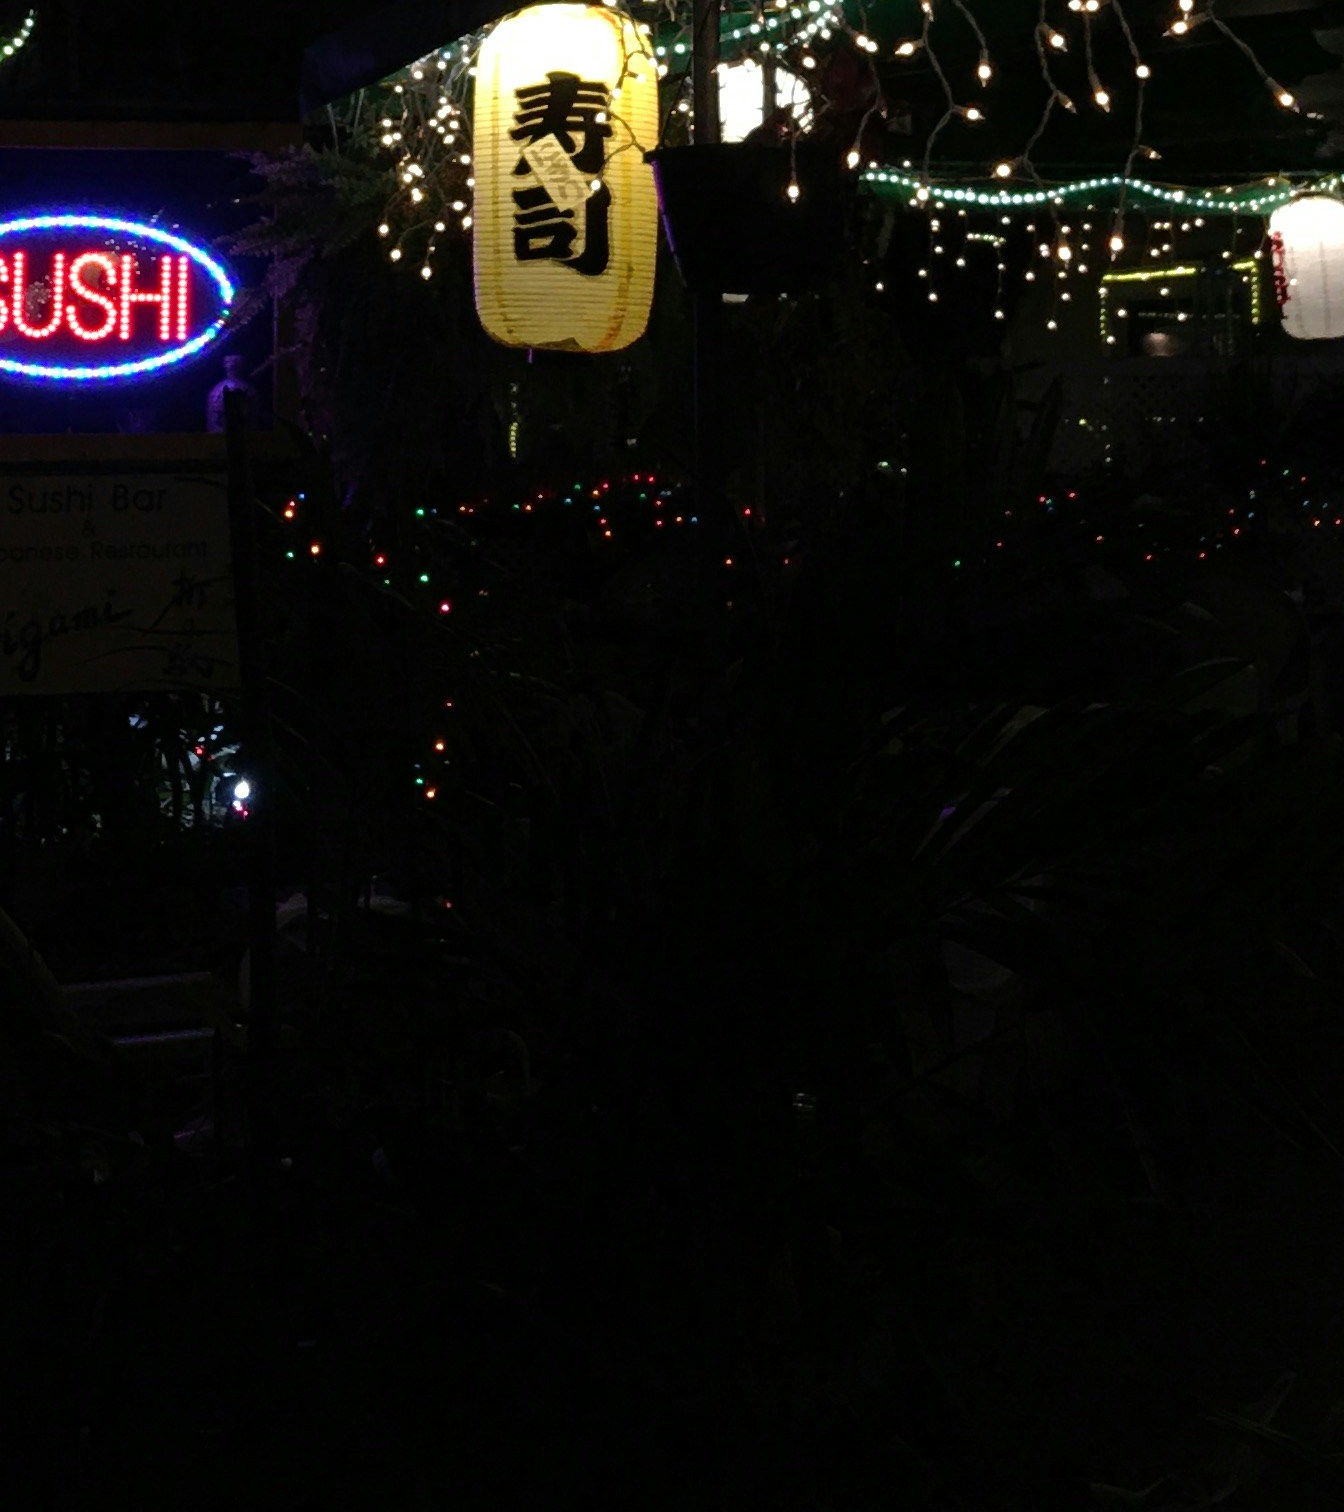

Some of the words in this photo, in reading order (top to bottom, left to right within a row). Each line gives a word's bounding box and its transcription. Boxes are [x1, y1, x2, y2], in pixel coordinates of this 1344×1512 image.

[509, 72, 612, 276] 寿司
[7, 484, 94, 514] Sushi
[112, 484, 168, 512] Bar
[81, 519, 96, 538] &
[91, 540, 209, 562] Restaurant
